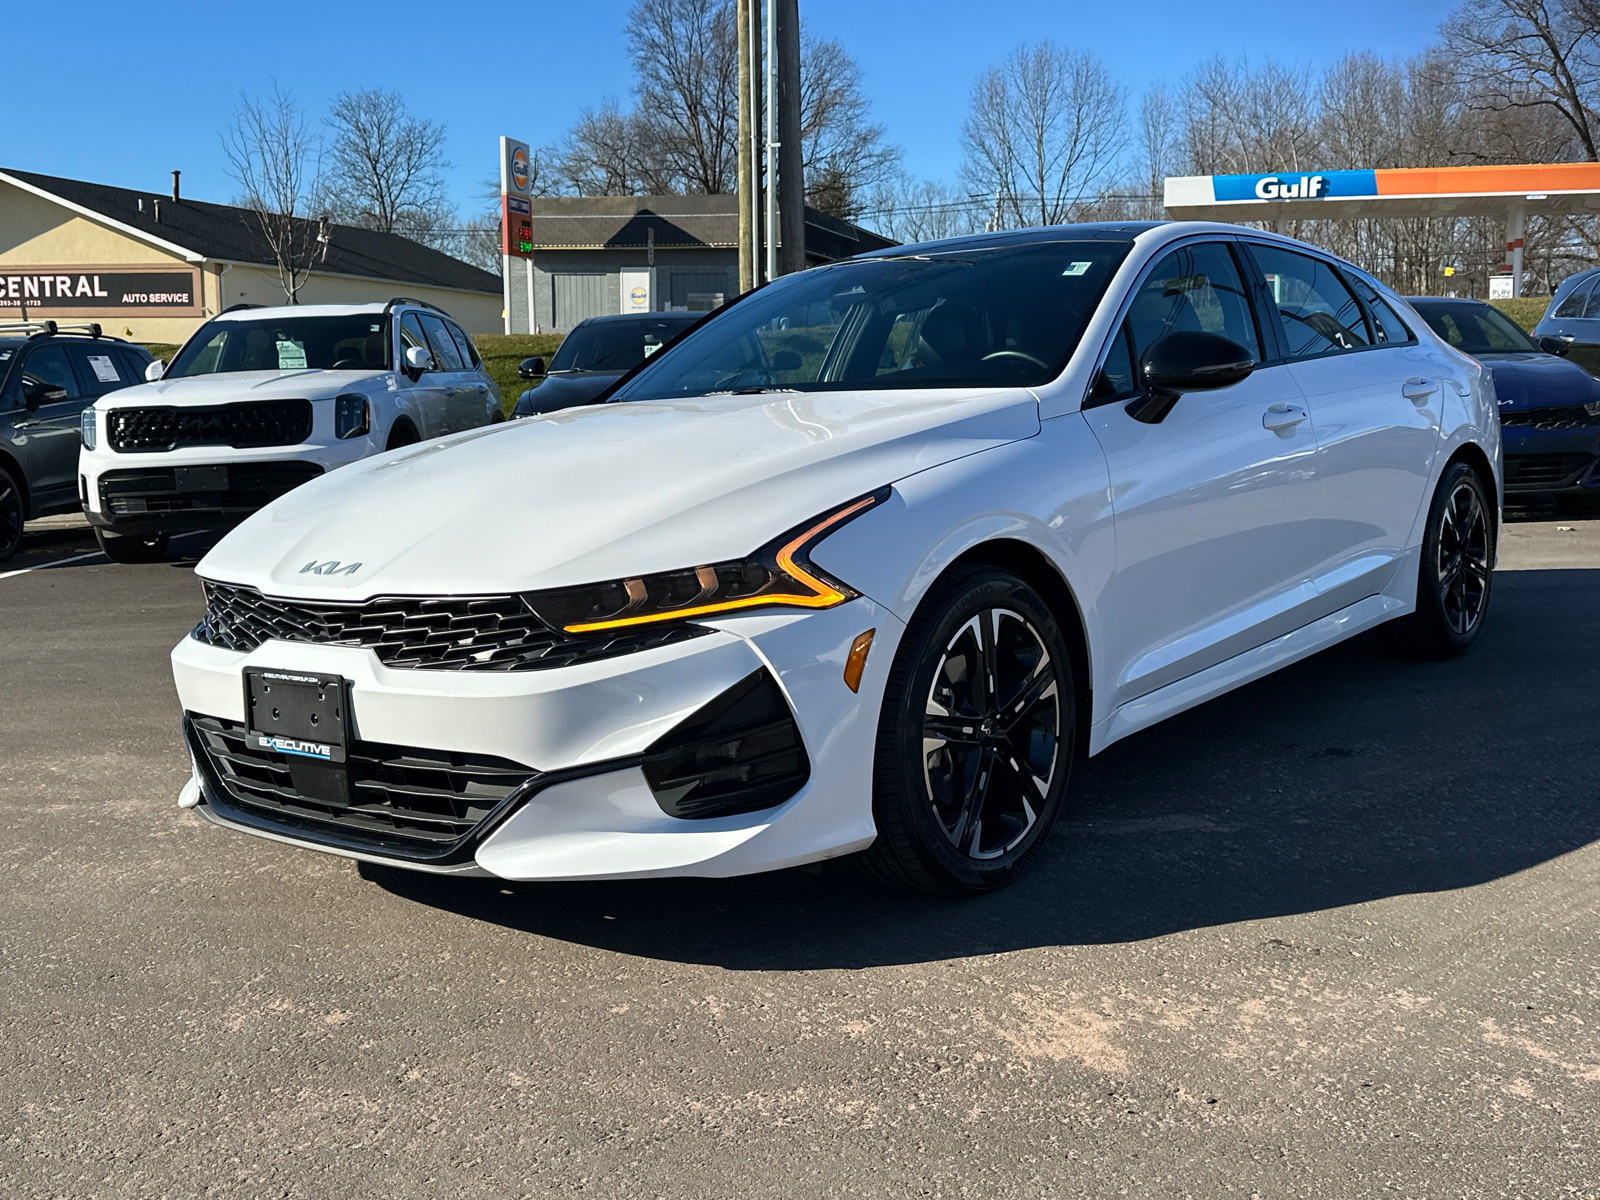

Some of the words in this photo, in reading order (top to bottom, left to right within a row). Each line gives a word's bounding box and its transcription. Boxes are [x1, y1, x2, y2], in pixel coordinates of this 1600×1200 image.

[514, 161, 528, 176] Gulf
[1255, 176, 1322, 198] Gulf
[122, 293, 148, 303] AUTO
[149, 293, 189, 303] SERVICE
[258, 736, 331, 755] EXECUTIVE
